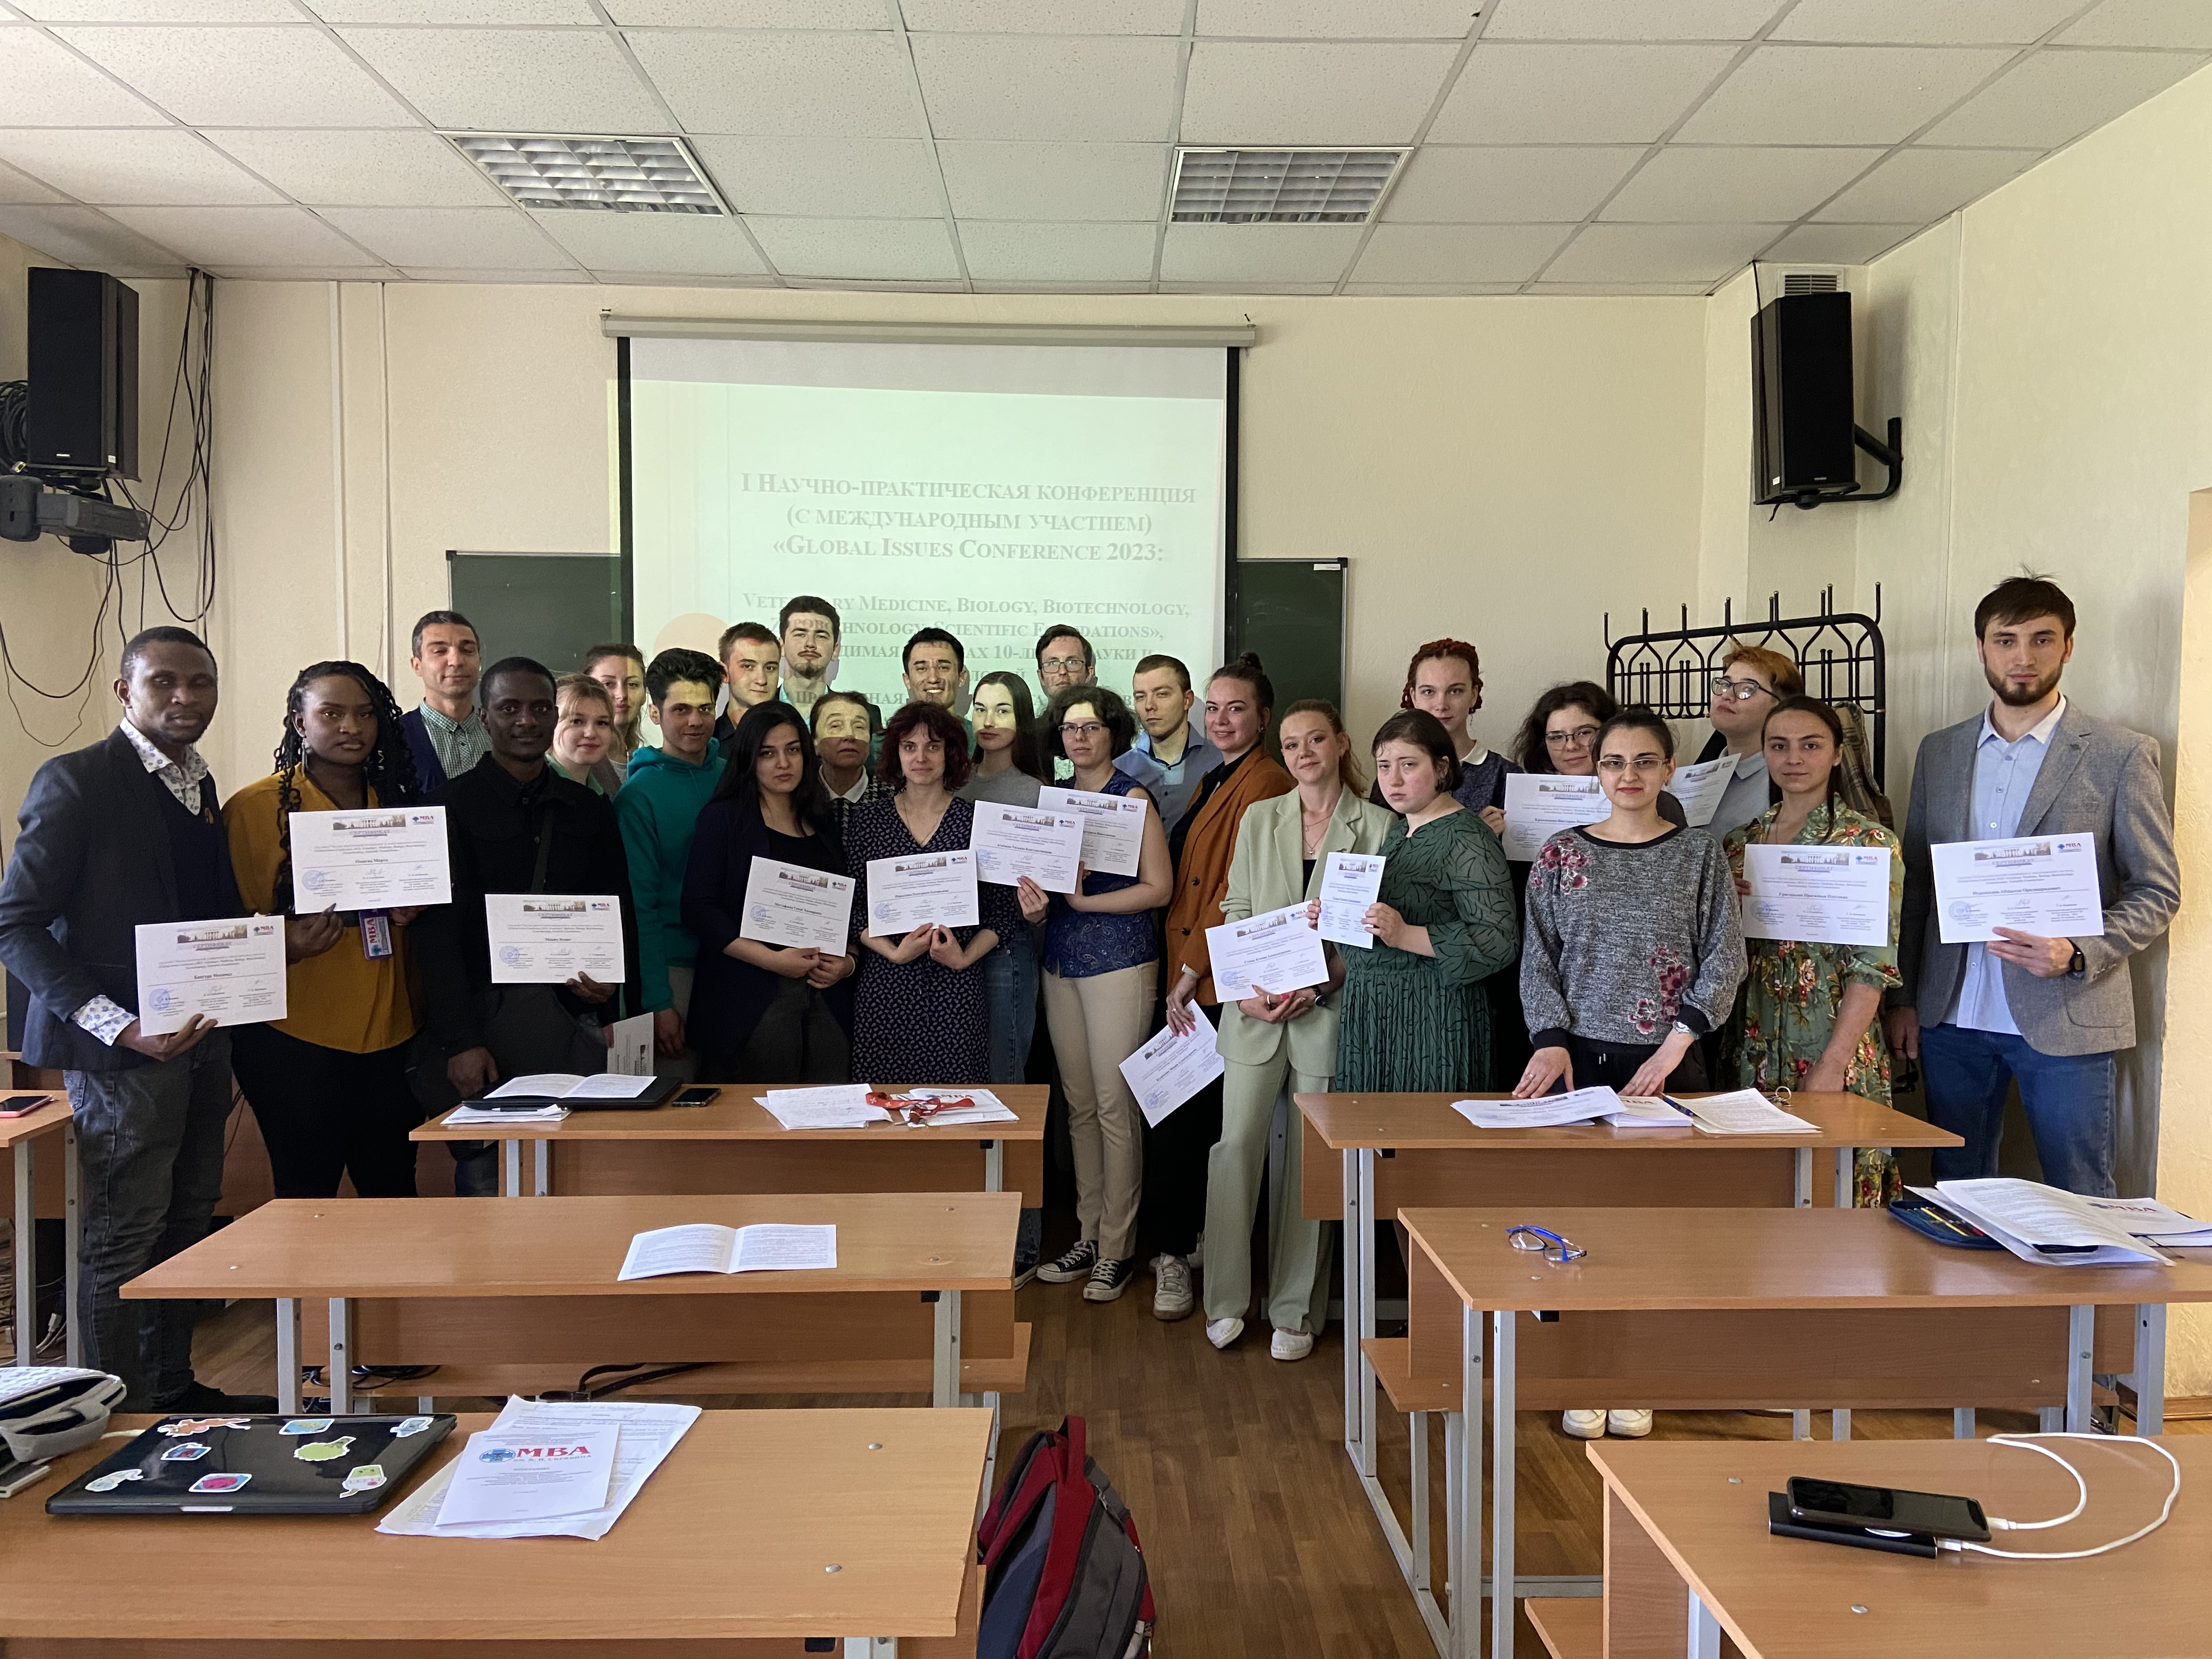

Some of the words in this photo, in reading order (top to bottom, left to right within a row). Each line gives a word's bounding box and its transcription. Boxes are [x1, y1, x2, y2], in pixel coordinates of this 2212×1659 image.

[757, 473, 1031, 500] НАУЧНО-ПРАКТИЧЕСКАЯ
[1036, 484, 1197, 506] КОНФЕРЕНЦИЯ
[816, 509, 1022, 531] МЕЖДУНАРОДНЫМ
[1029, 514, 1153, 536] УЧАСТИЕМ)
[772, 534, 877, 556] «GLOBAL
[881, 537, 953, 557] ISSUES
[958, 539, 1101, 561] CONFERENCE
[1107, 543, 1164, 562] 2023:
[742, 592, 856, 611] VETERY
[859, 595, 951, 614] MEDICINE,
[957, 597, 1037, 616] BIOLOGY,
[1043, 599, 1190, 619] BIOTECHNOLOGY,
[1033, 622, 1165, 640] FDATIONS»,
[1093, 648, 1137, 661] АУКИ
[516, 1446, 591, 1458] МВА
